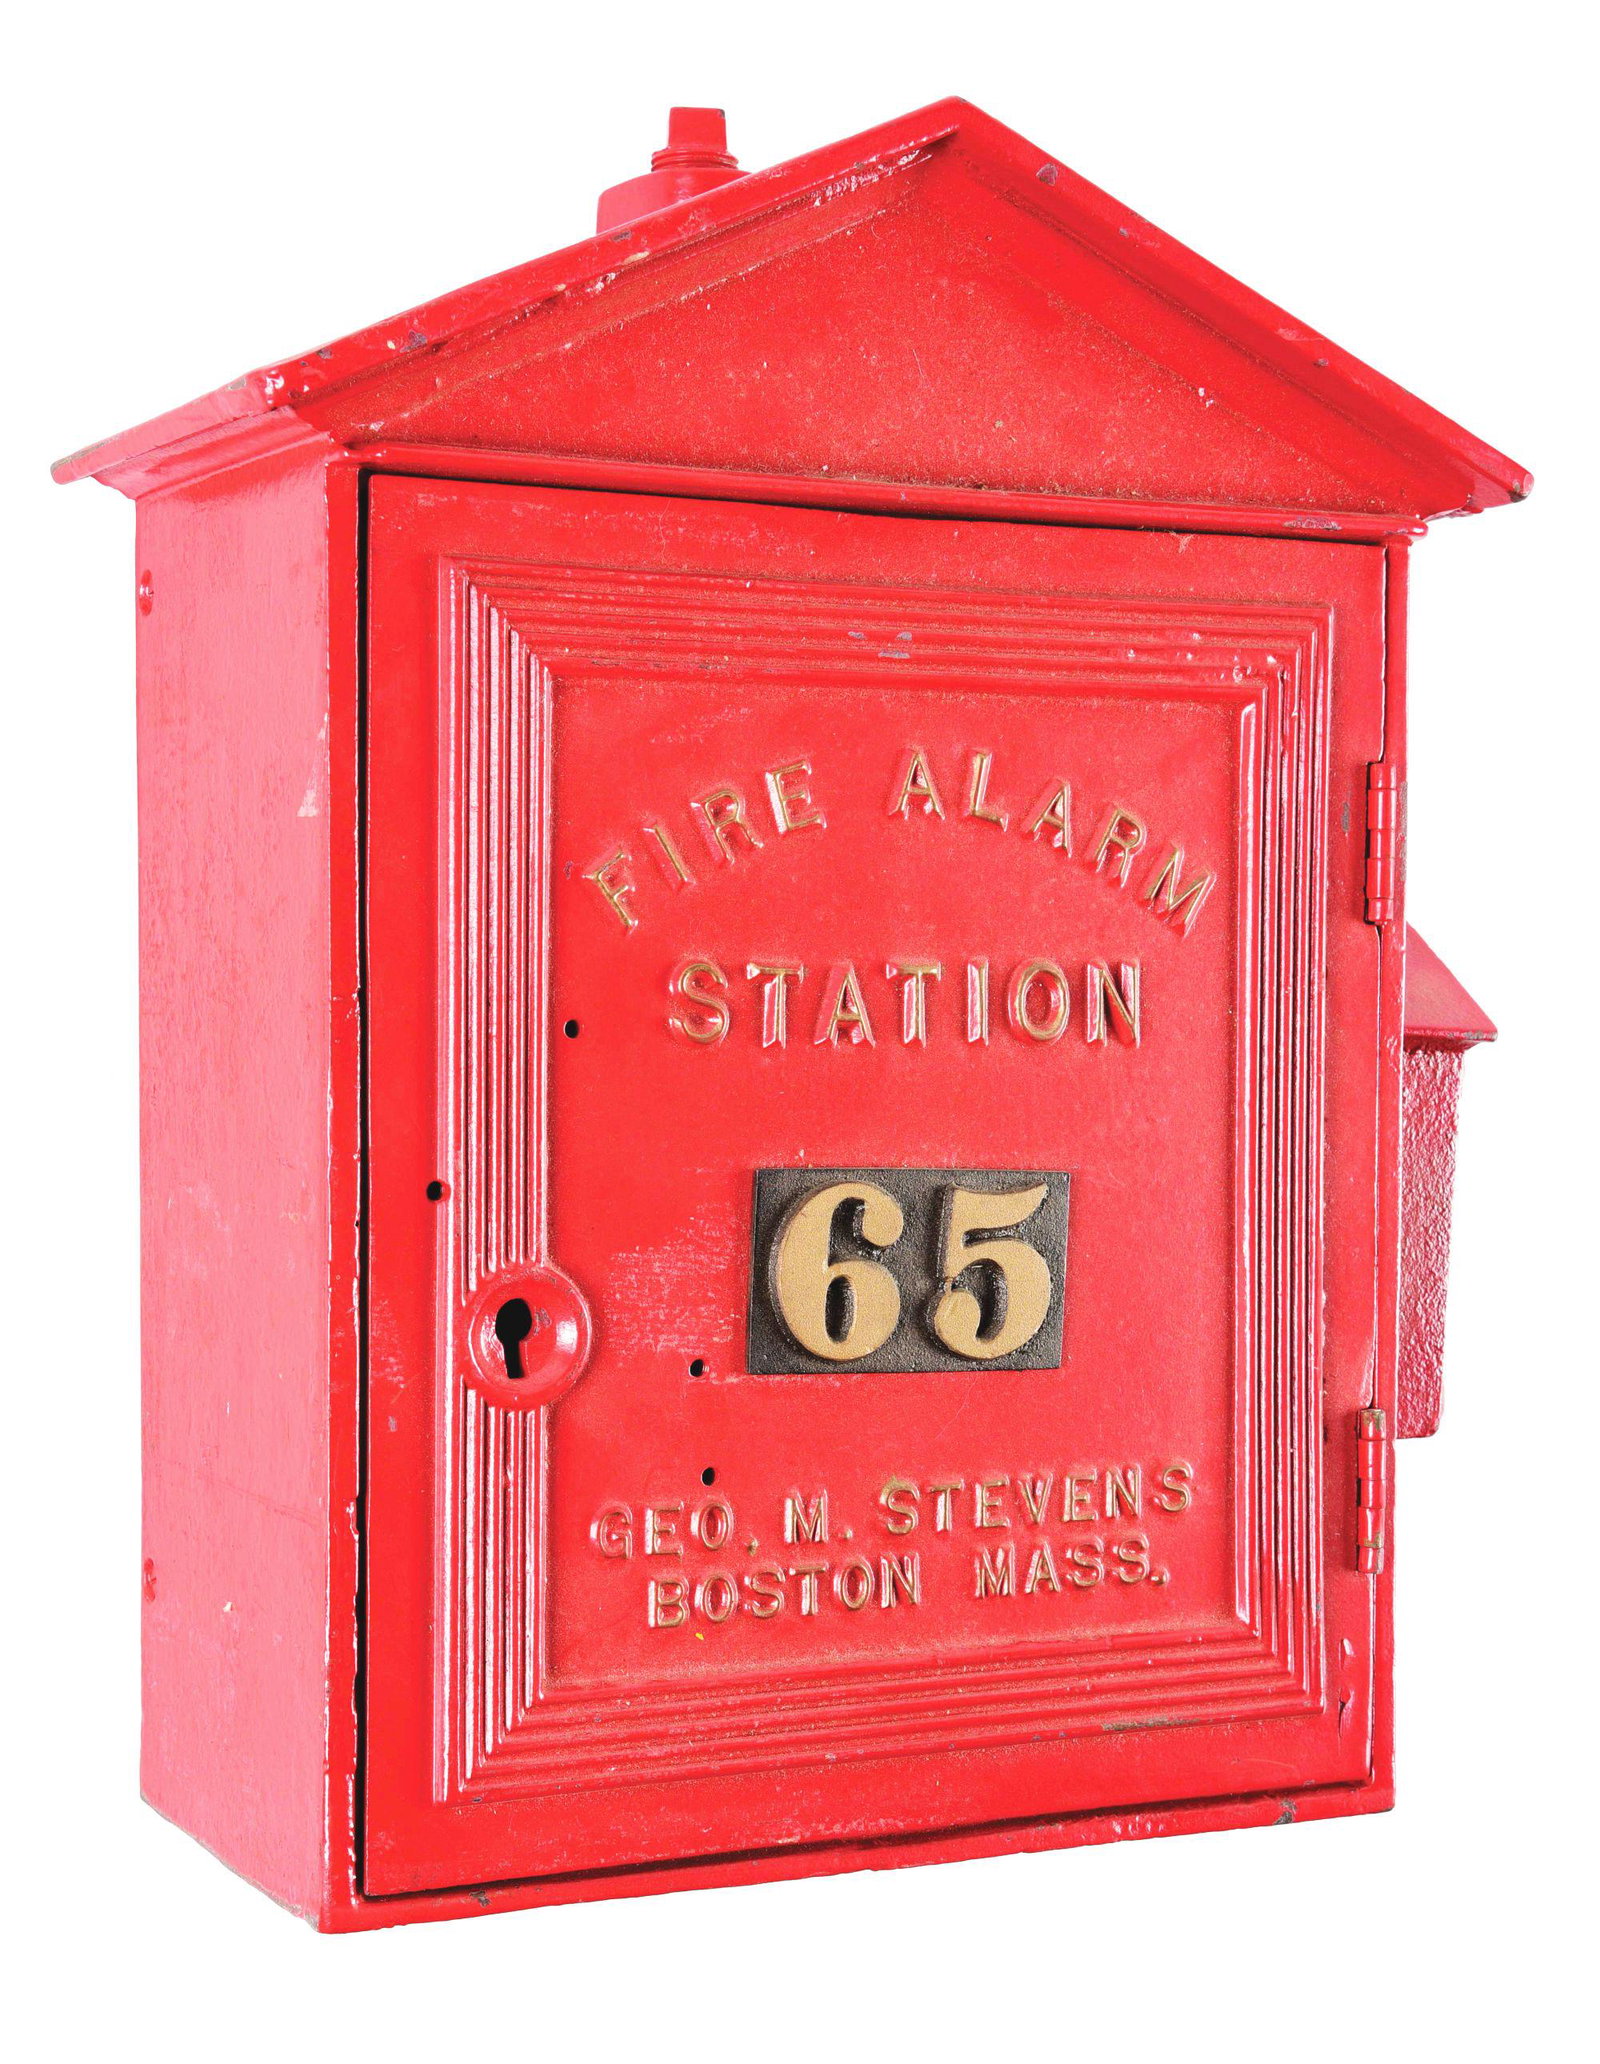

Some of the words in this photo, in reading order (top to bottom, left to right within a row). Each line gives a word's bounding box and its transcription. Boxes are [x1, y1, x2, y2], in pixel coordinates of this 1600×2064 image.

[583, 757, 827, 934] FIRE
[888, 748, 1216, 937] ALARM
[668, 959, 1142, 1049] STATION
[773, 1180, 1051, 1362] 65
[784, 1487, 852, 1545] M.
[880, 1460, 1195, 1536] STEVENS
[648, 1552, 922, 1629] BOSTON
